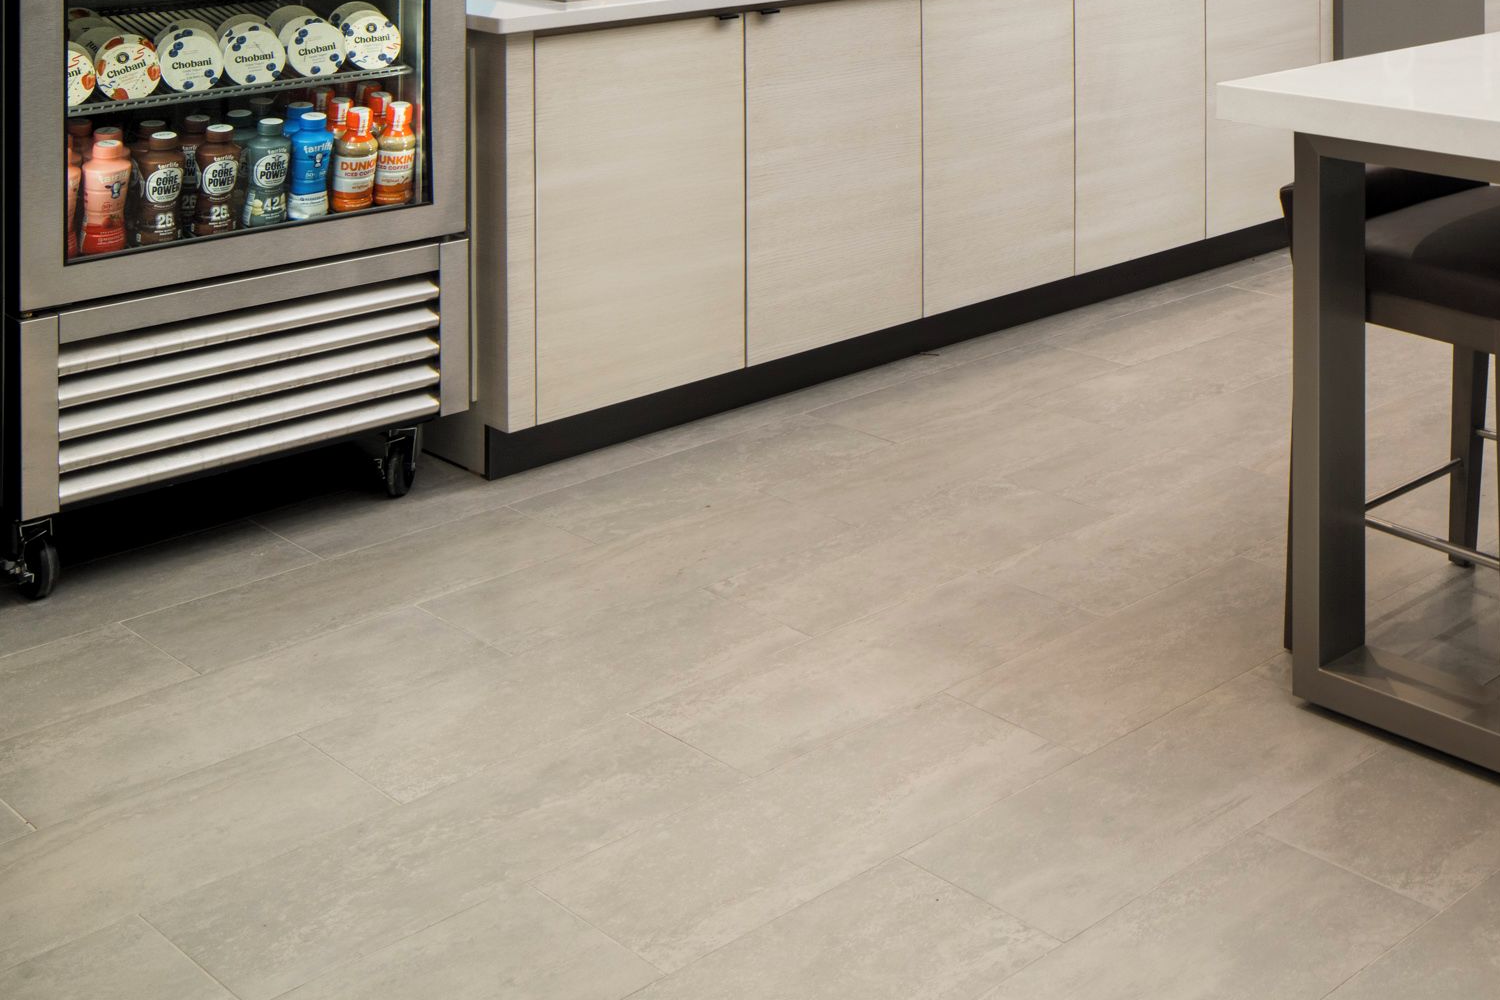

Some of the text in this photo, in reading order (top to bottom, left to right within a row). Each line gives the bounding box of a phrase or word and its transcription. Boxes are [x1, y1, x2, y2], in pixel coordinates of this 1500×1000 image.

[354, 33, 391, 44] Chobani
[298, 41, 337, 57] Chobani
[171, 57, 213, 70] Chobani
[234, 51, 274, 64] Chobani
[106, 59, 147, 79] Chobani
[267, 147, 287, 155] fairlife
[303, 139, 333, 154] fairlife
[213, 154, 234, 162] fairlife
[158, 161, 179, 170] fairlife
[264, 161, 286, 171] CORE
[211, 167, 234, 178] CORE
[259, 168, 287, 180] POWER
[155, 174, 178, 186] CORE
[208, 175, 235, 187] POWER
[151, 183, 180, 197] POWER
